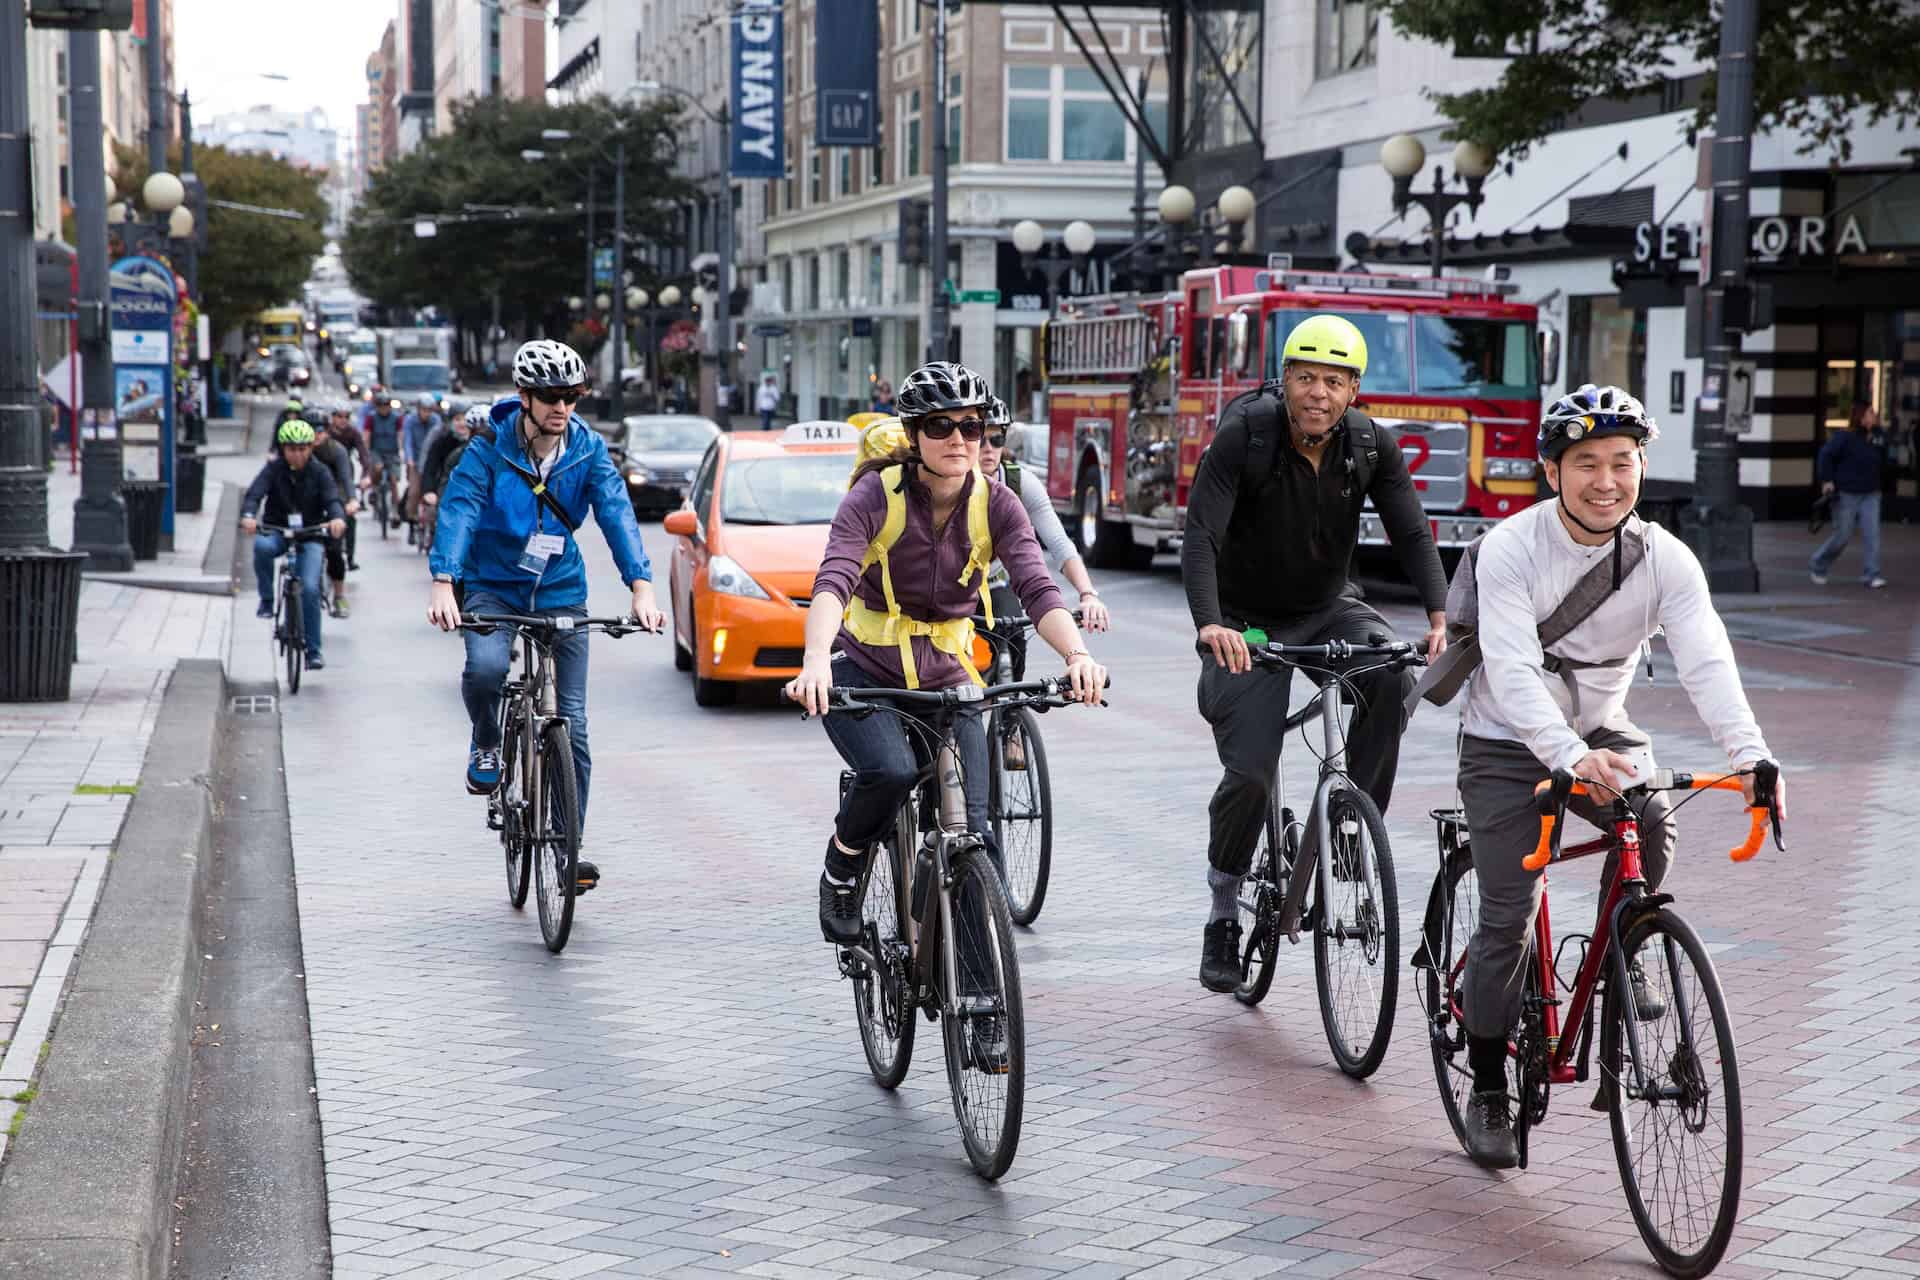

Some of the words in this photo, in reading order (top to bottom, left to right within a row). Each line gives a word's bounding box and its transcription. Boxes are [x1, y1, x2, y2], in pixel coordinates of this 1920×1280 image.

[741, 51, 775, 160] NAVY
[831, 103, 864, 129] GAP
[1634, 214, 1867, 262] SEPORA
[804, 427, 841, 440] TAXI
